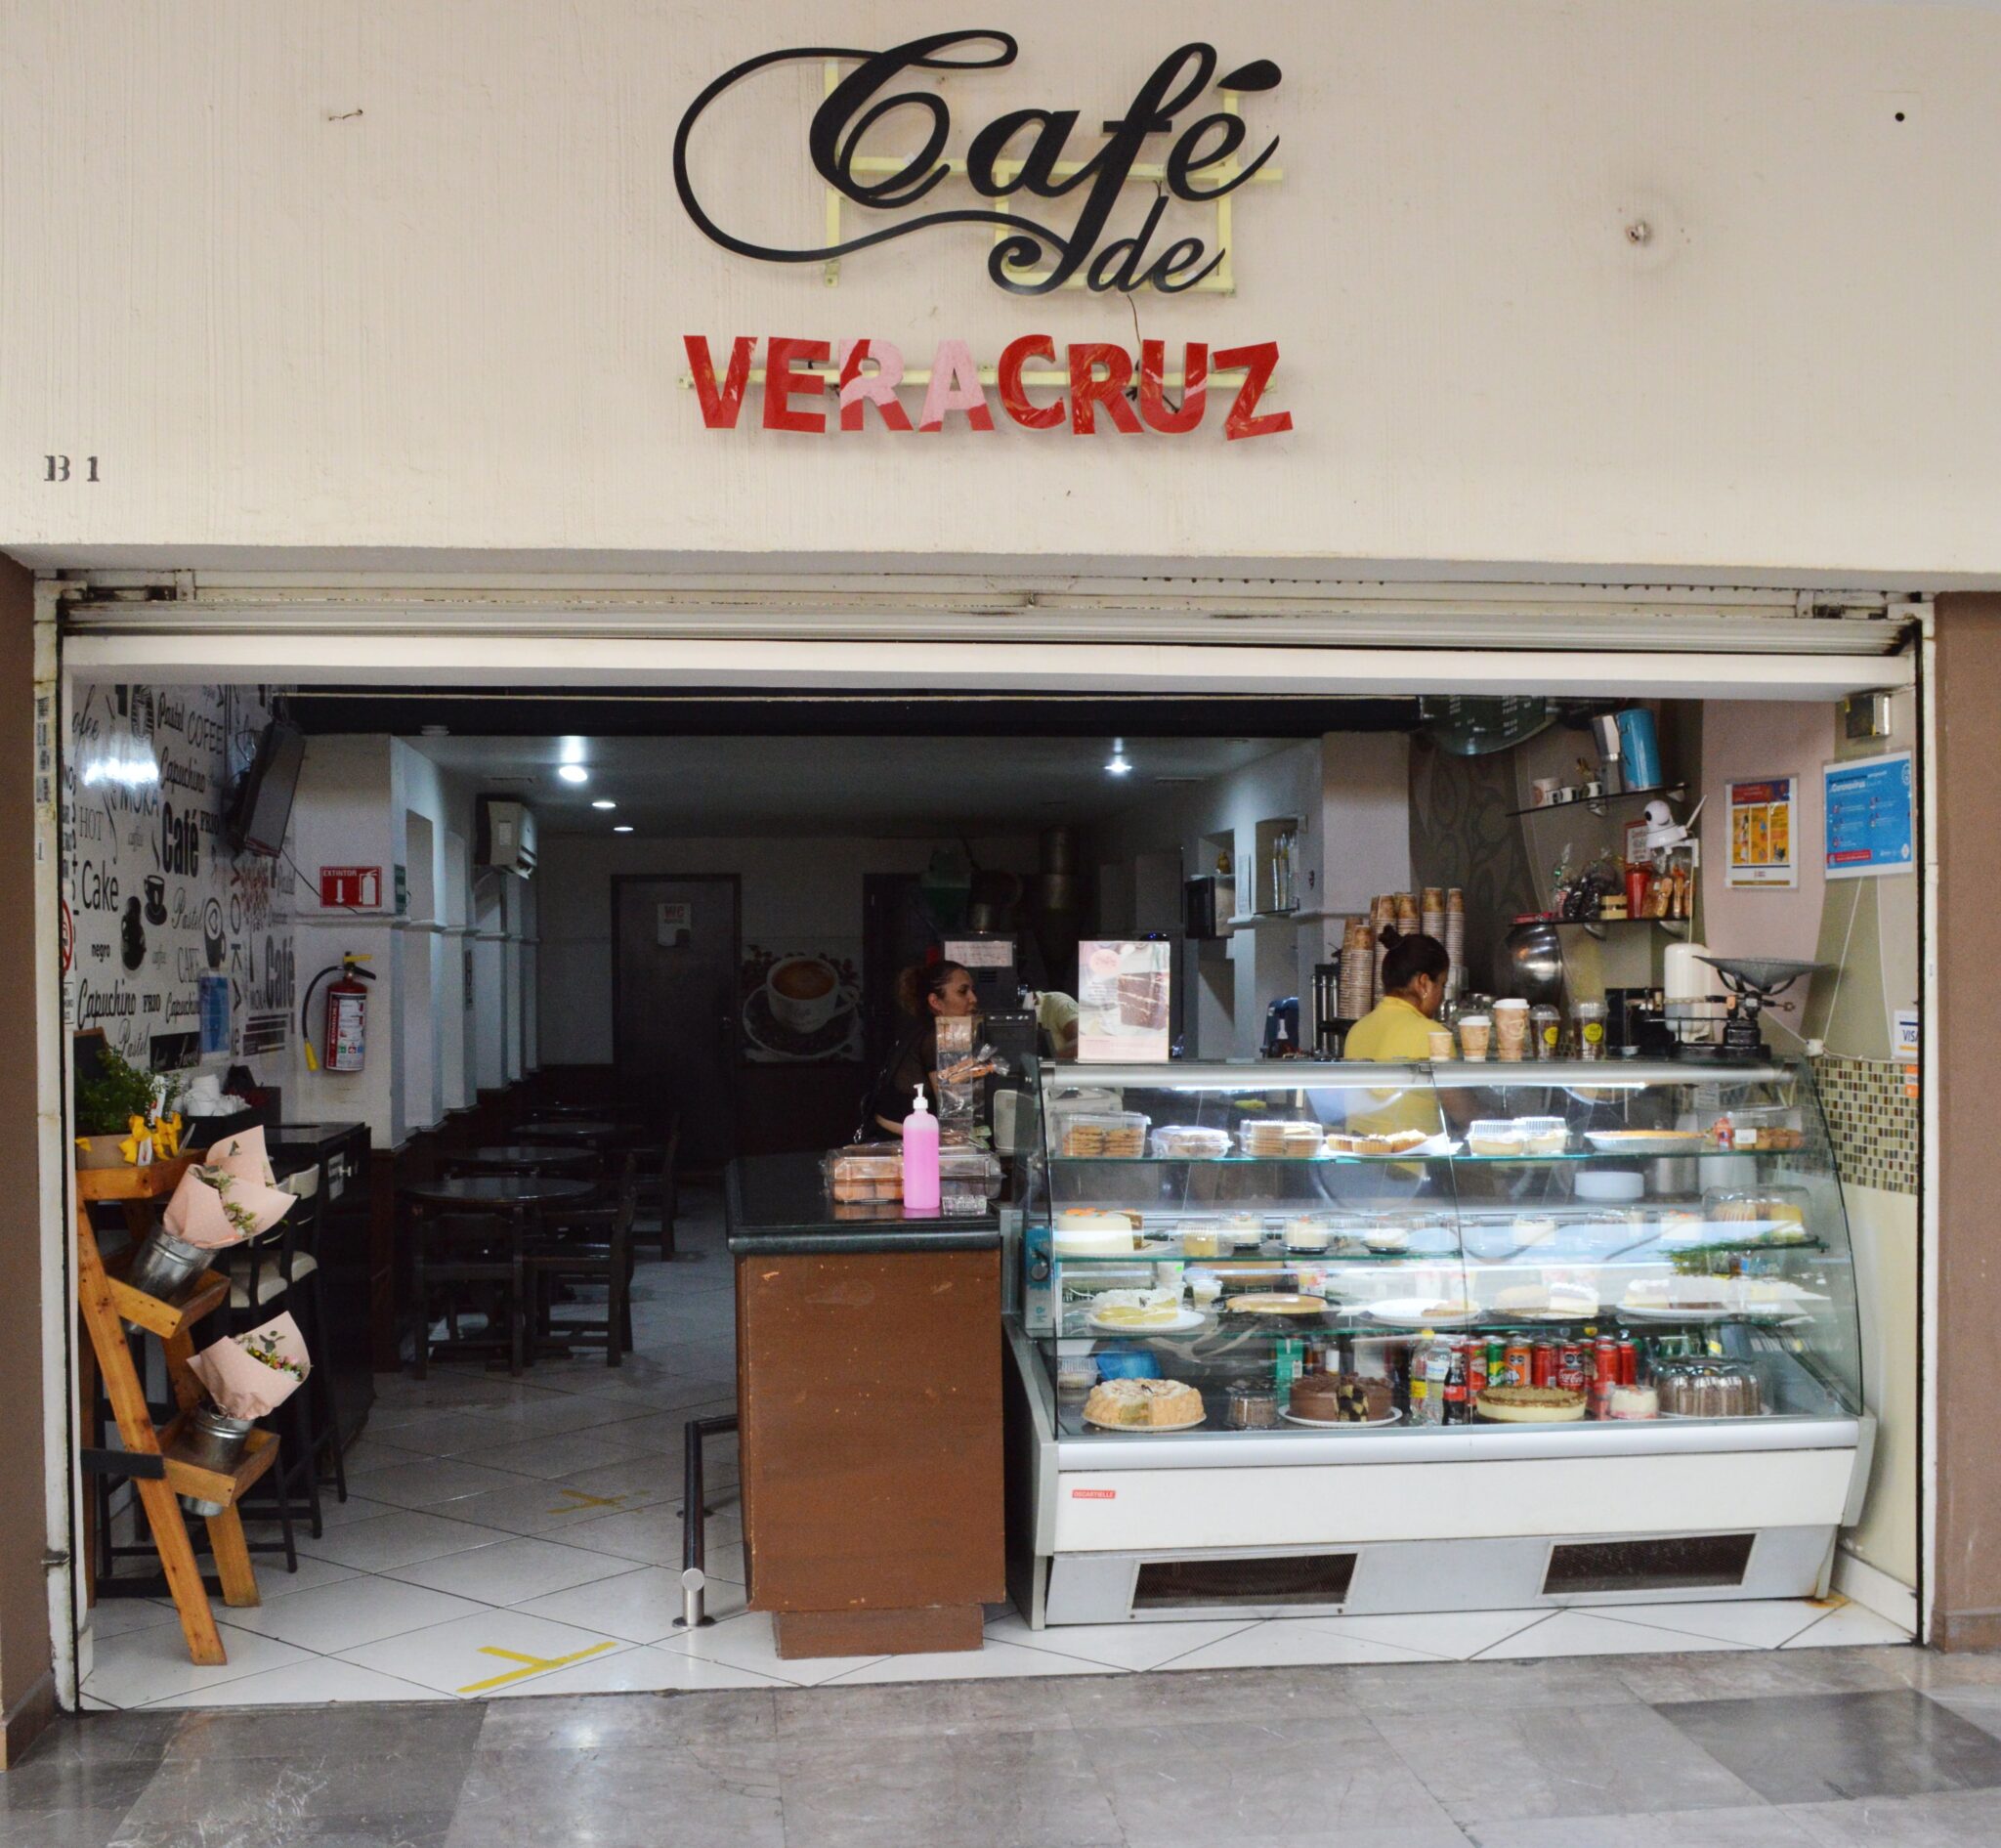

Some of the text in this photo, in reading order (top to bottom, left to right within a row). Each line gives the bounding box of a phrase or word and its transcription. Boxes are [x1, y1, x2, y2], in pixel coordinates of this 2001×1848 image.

[672, 29, 1282, 295] Café
[1087, 195, 1225, 294] de
[684, 334, 1294, 441] VERACRUZ
[44, 454, 100, 482] B 1
[188, 711, 224, 755] COFEE
[79, 806, 104, 840] HOT
[162, 801, 199, 878] Café
[82, 860, 118, 912] Cake
[323, 869, 358, 878] EXTINTOR
[91, 944, 110, 963] negro
[265, 933, 295, 1010] Café
[77, 977, 136, 1031] Capuchino
[118, 1017, 150, 1058] Pastel
